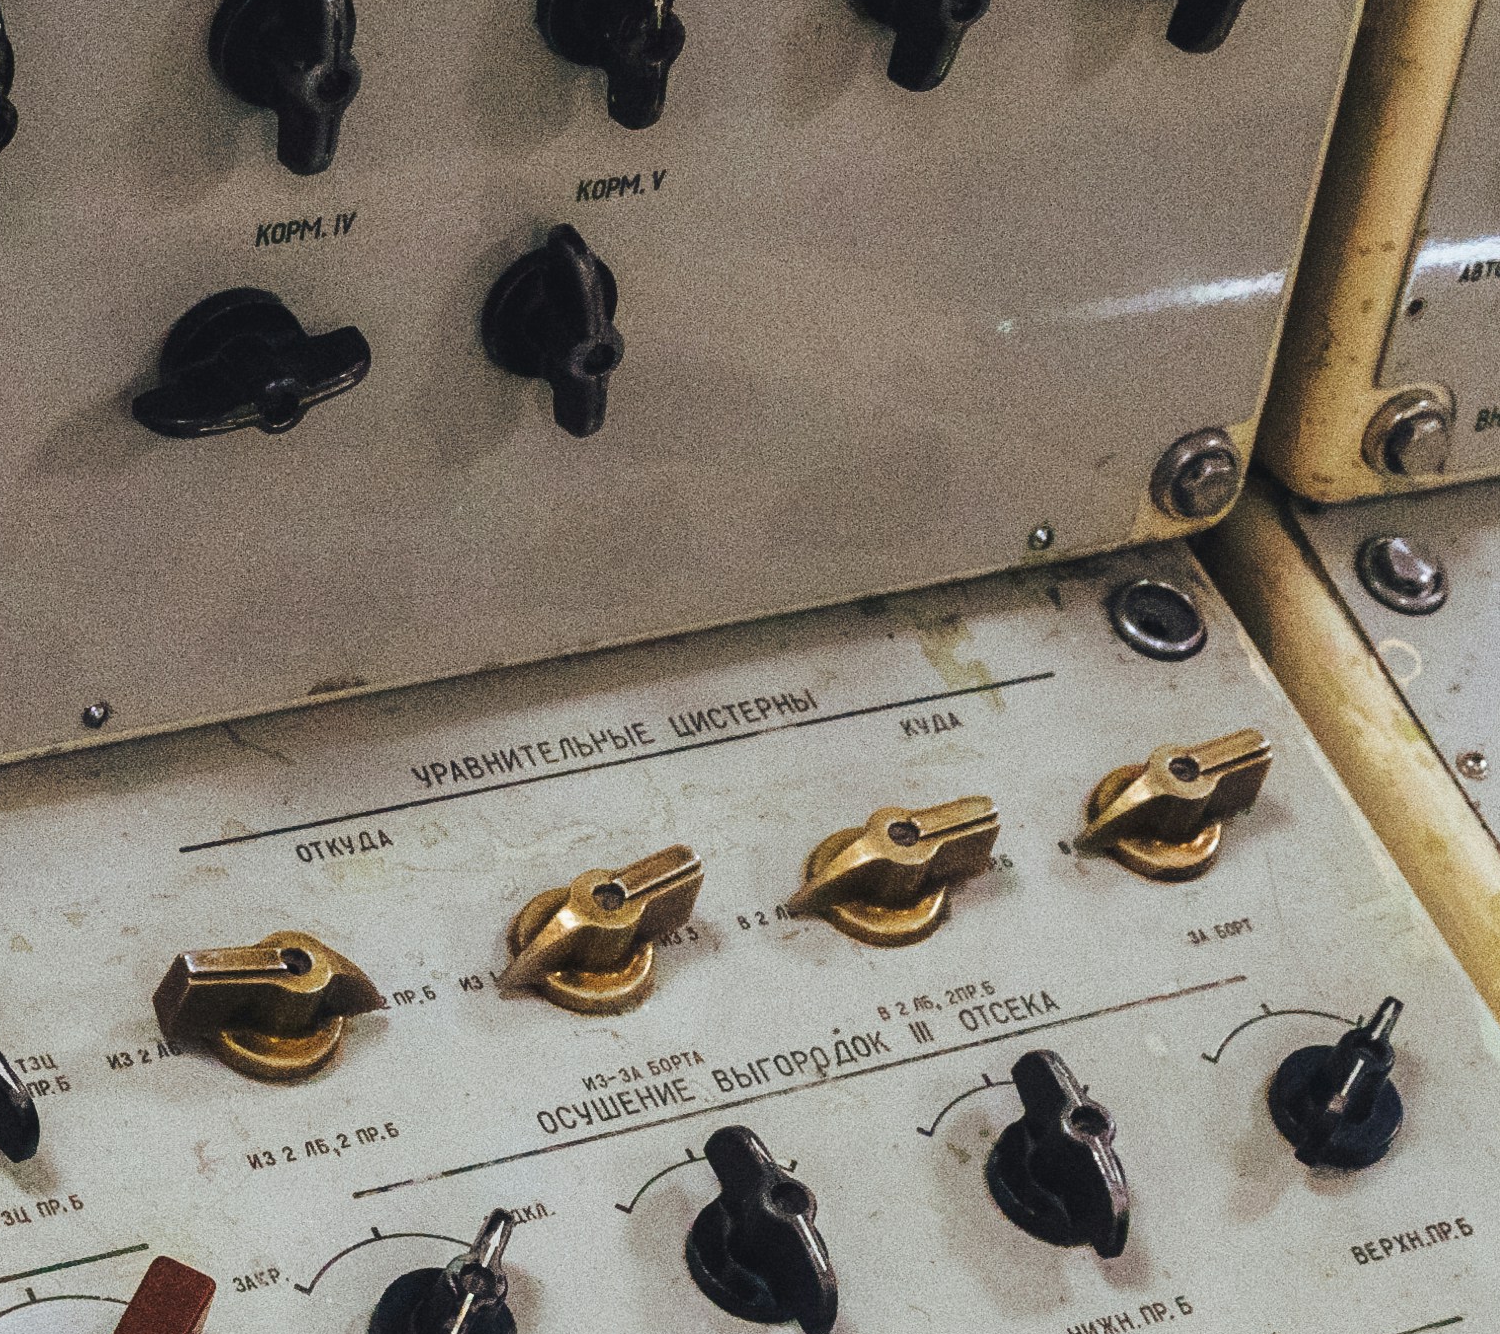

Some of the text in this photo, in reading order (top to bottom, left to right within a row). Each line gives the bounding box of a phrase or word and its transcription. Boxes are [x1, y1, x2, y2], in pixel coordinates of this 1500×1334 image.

[576, 175, 646, 202] КОРМ.
[255, 217, 327, 249] КОРМ.
[410, 688, 820, 791] УРАВНИТЕЛЬНЫЕ ЦИСТЕРНЫ
[900, 711, 965, 739] КУДА
[295, 829, 393, 864] ОТКУДА
[1214, 918, 1253, 939] БОРТ
[536, 1078, 698, 1137] ОСУШЕНИЕ
[711, 1031, 892, 1095] ВЫГОРОДОК
[959, 989, 1062, 1034] ОТСЕКА
[582, 1050, 705, 1092] ИЗ-ЗА БОРТА
[281, 1145, 298, 1164] 2
[232, 1269, 291, 1295] ЗАКР.
